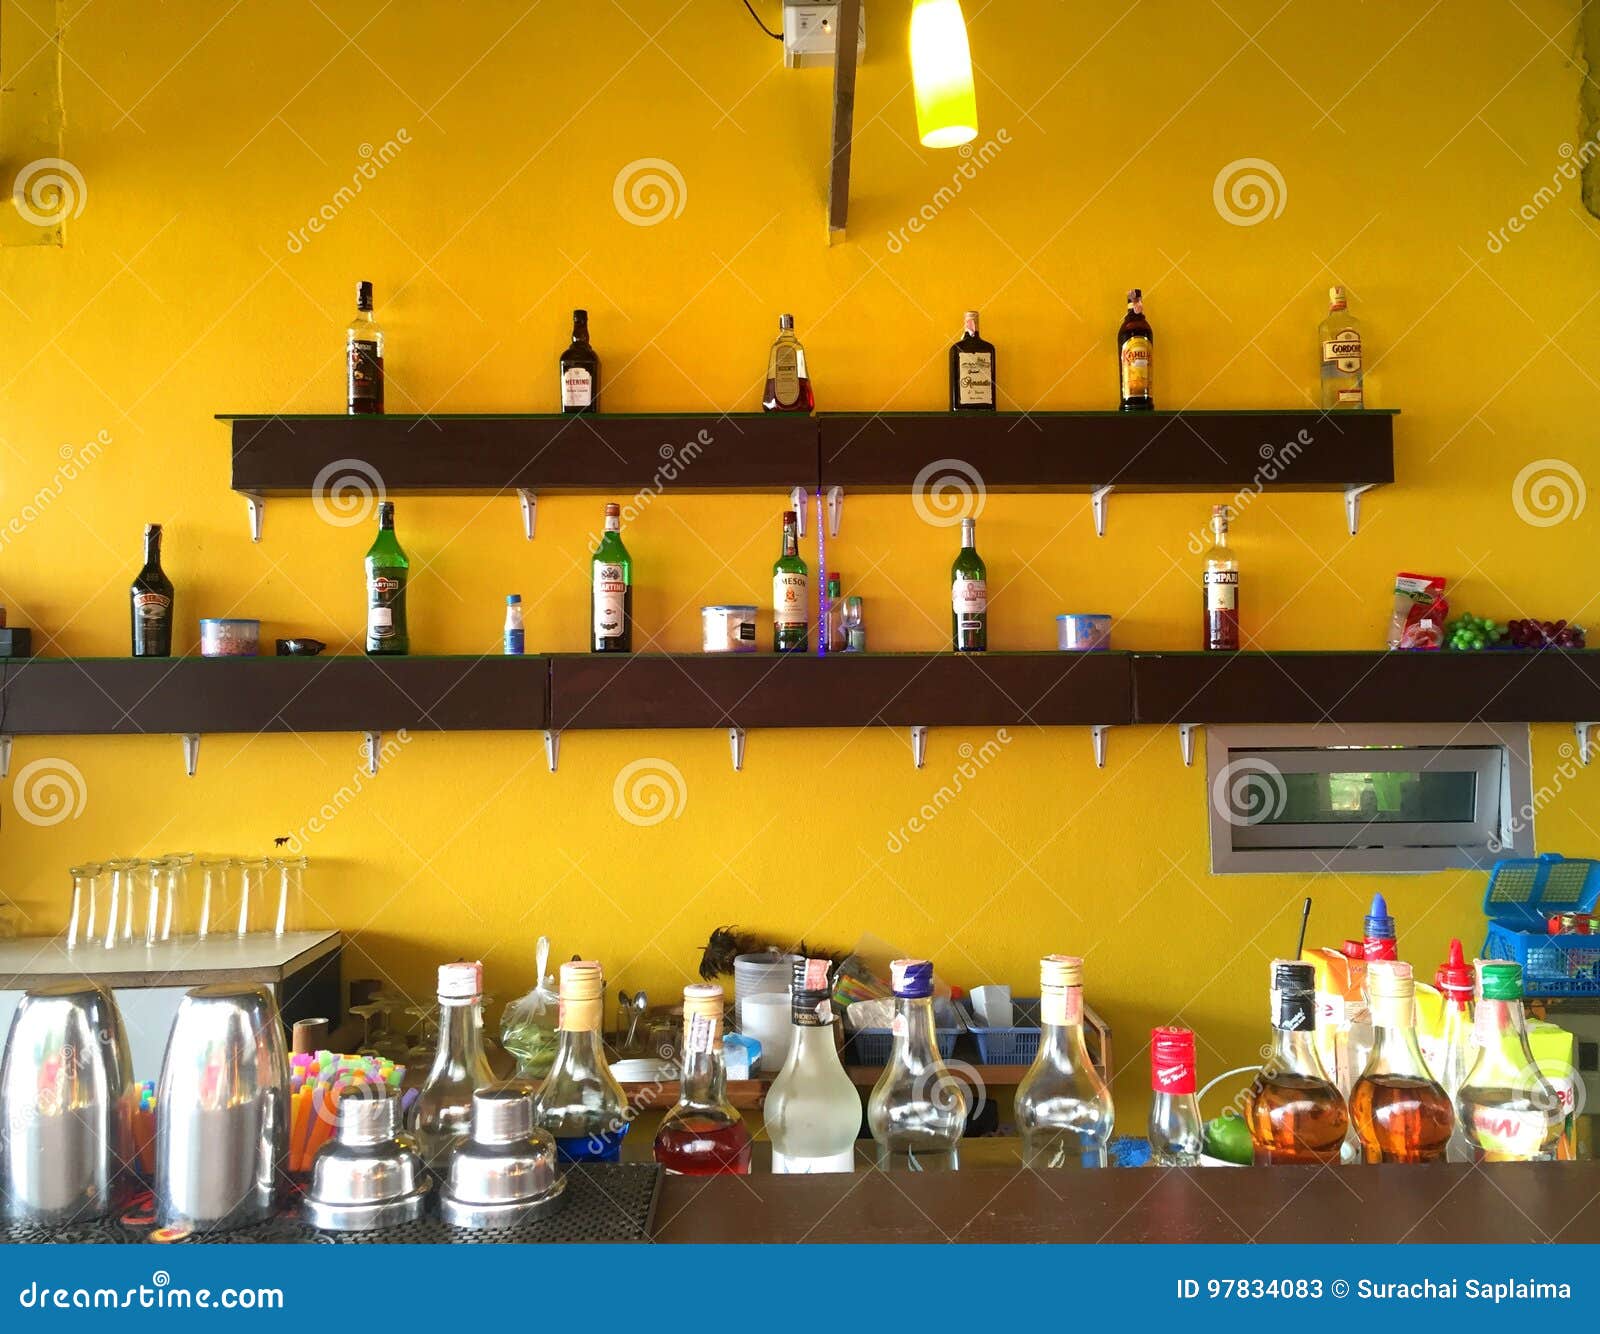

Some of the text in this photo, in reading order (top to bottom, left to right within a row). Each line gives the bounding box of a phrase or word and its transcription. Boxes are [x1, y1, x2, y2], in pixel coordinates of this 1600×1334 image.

[777, 577, 806, 588] MESON
[1204, 573, 1238, 583] CMPARI
[601, 583, 624, 591] ARTINI
